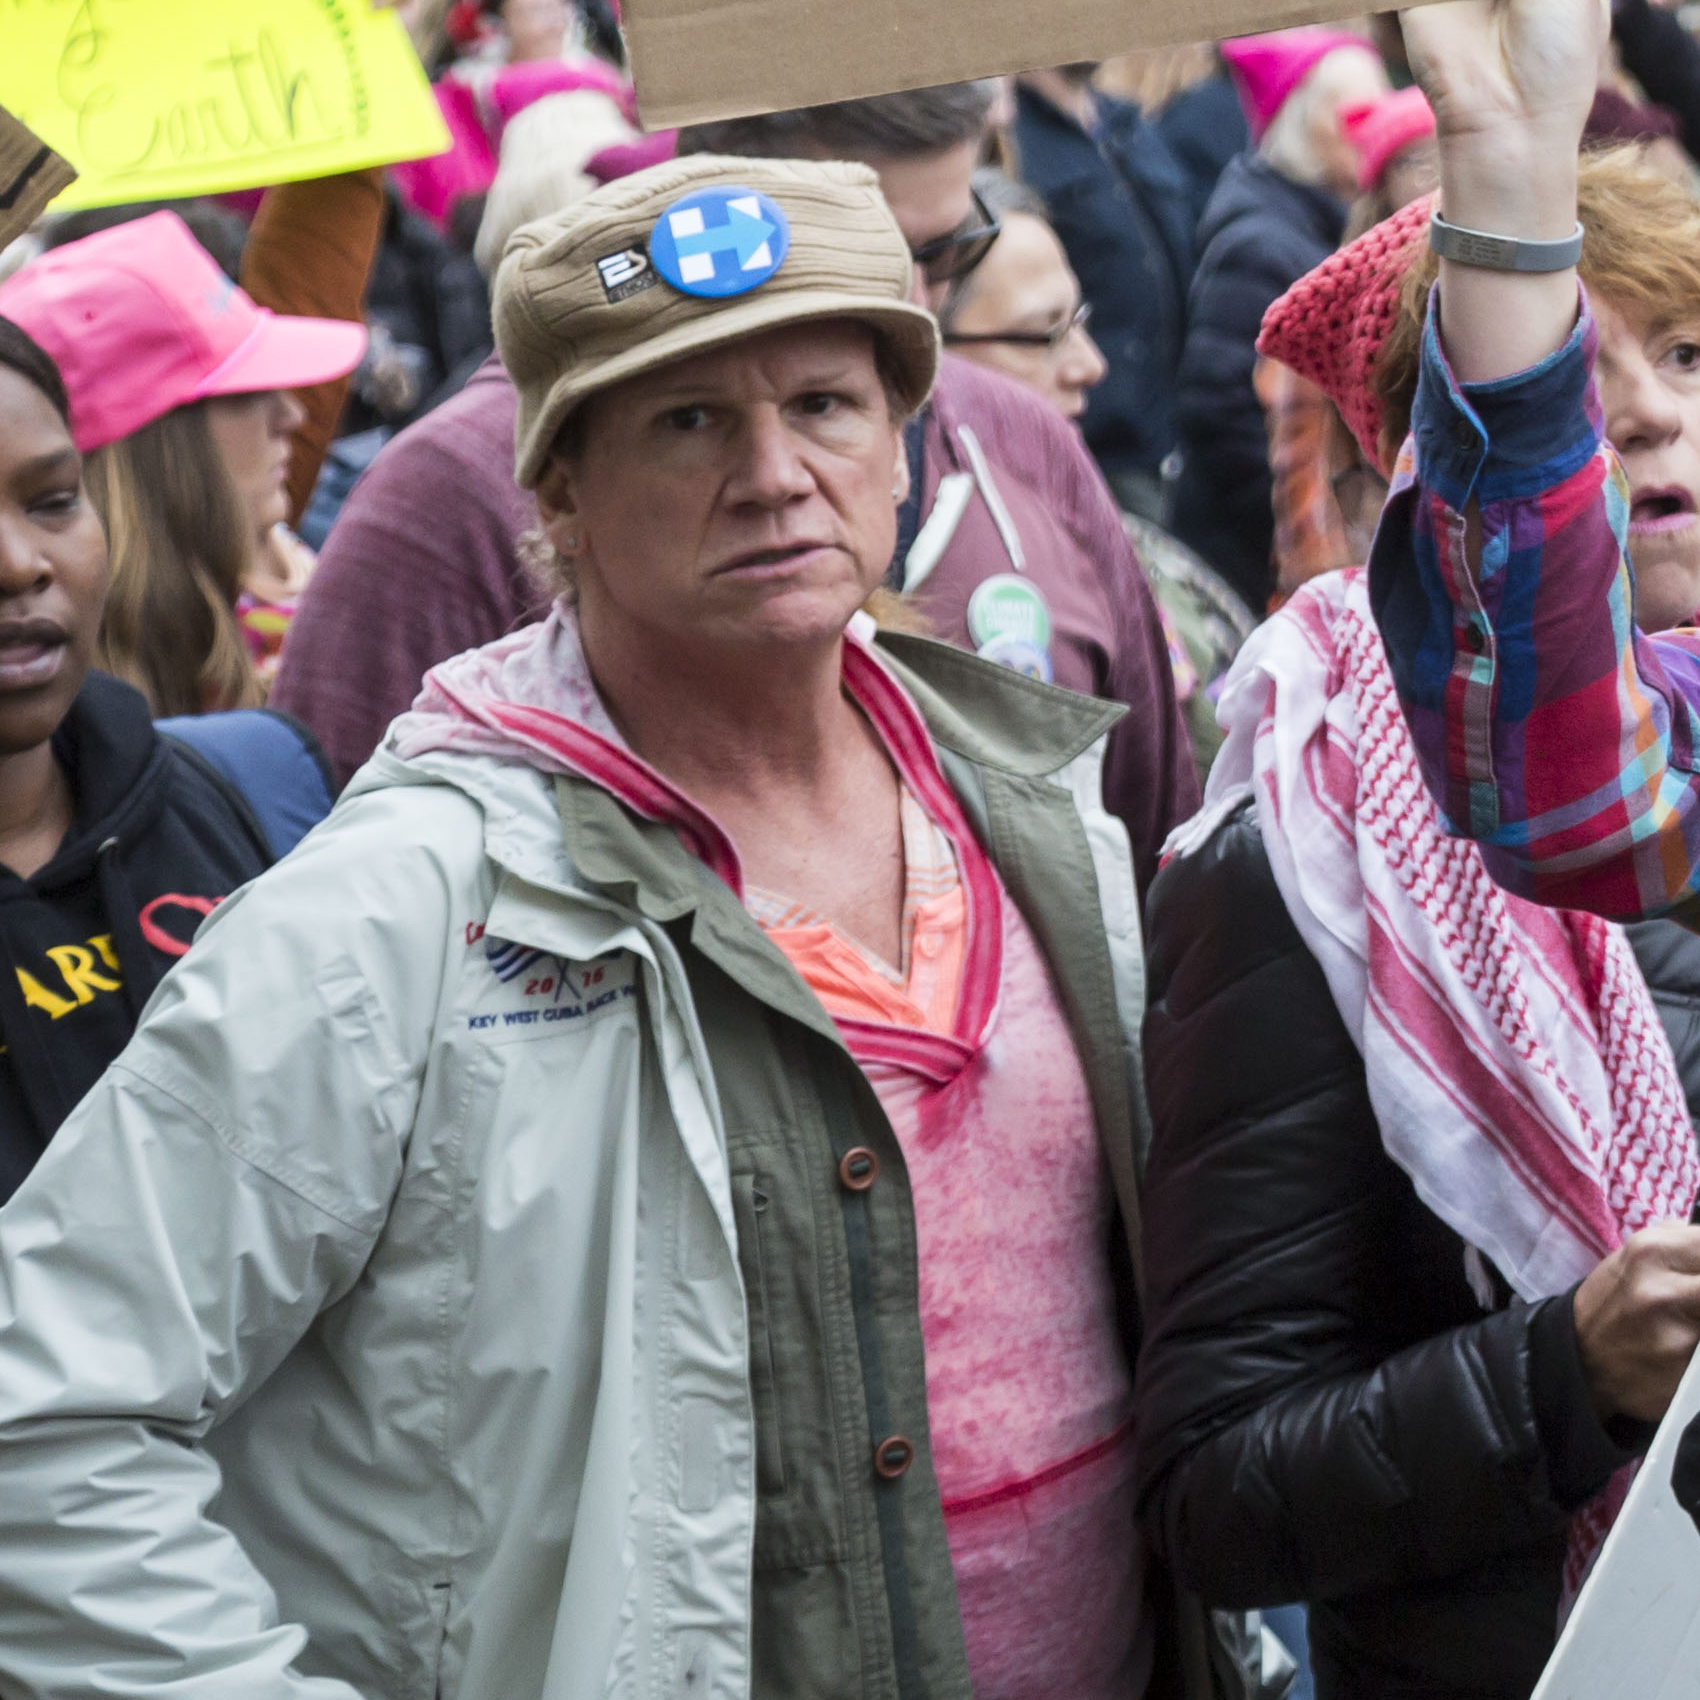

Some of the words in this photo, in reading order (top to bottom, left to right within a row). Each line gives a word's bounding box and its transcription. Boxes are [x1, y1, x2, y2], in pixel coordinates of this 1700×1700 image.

[468, 1013, 498, 1031] KEY
[503, 1010, 541, 1027] WEST
[543, 1004, 584, 1023] CUBA
